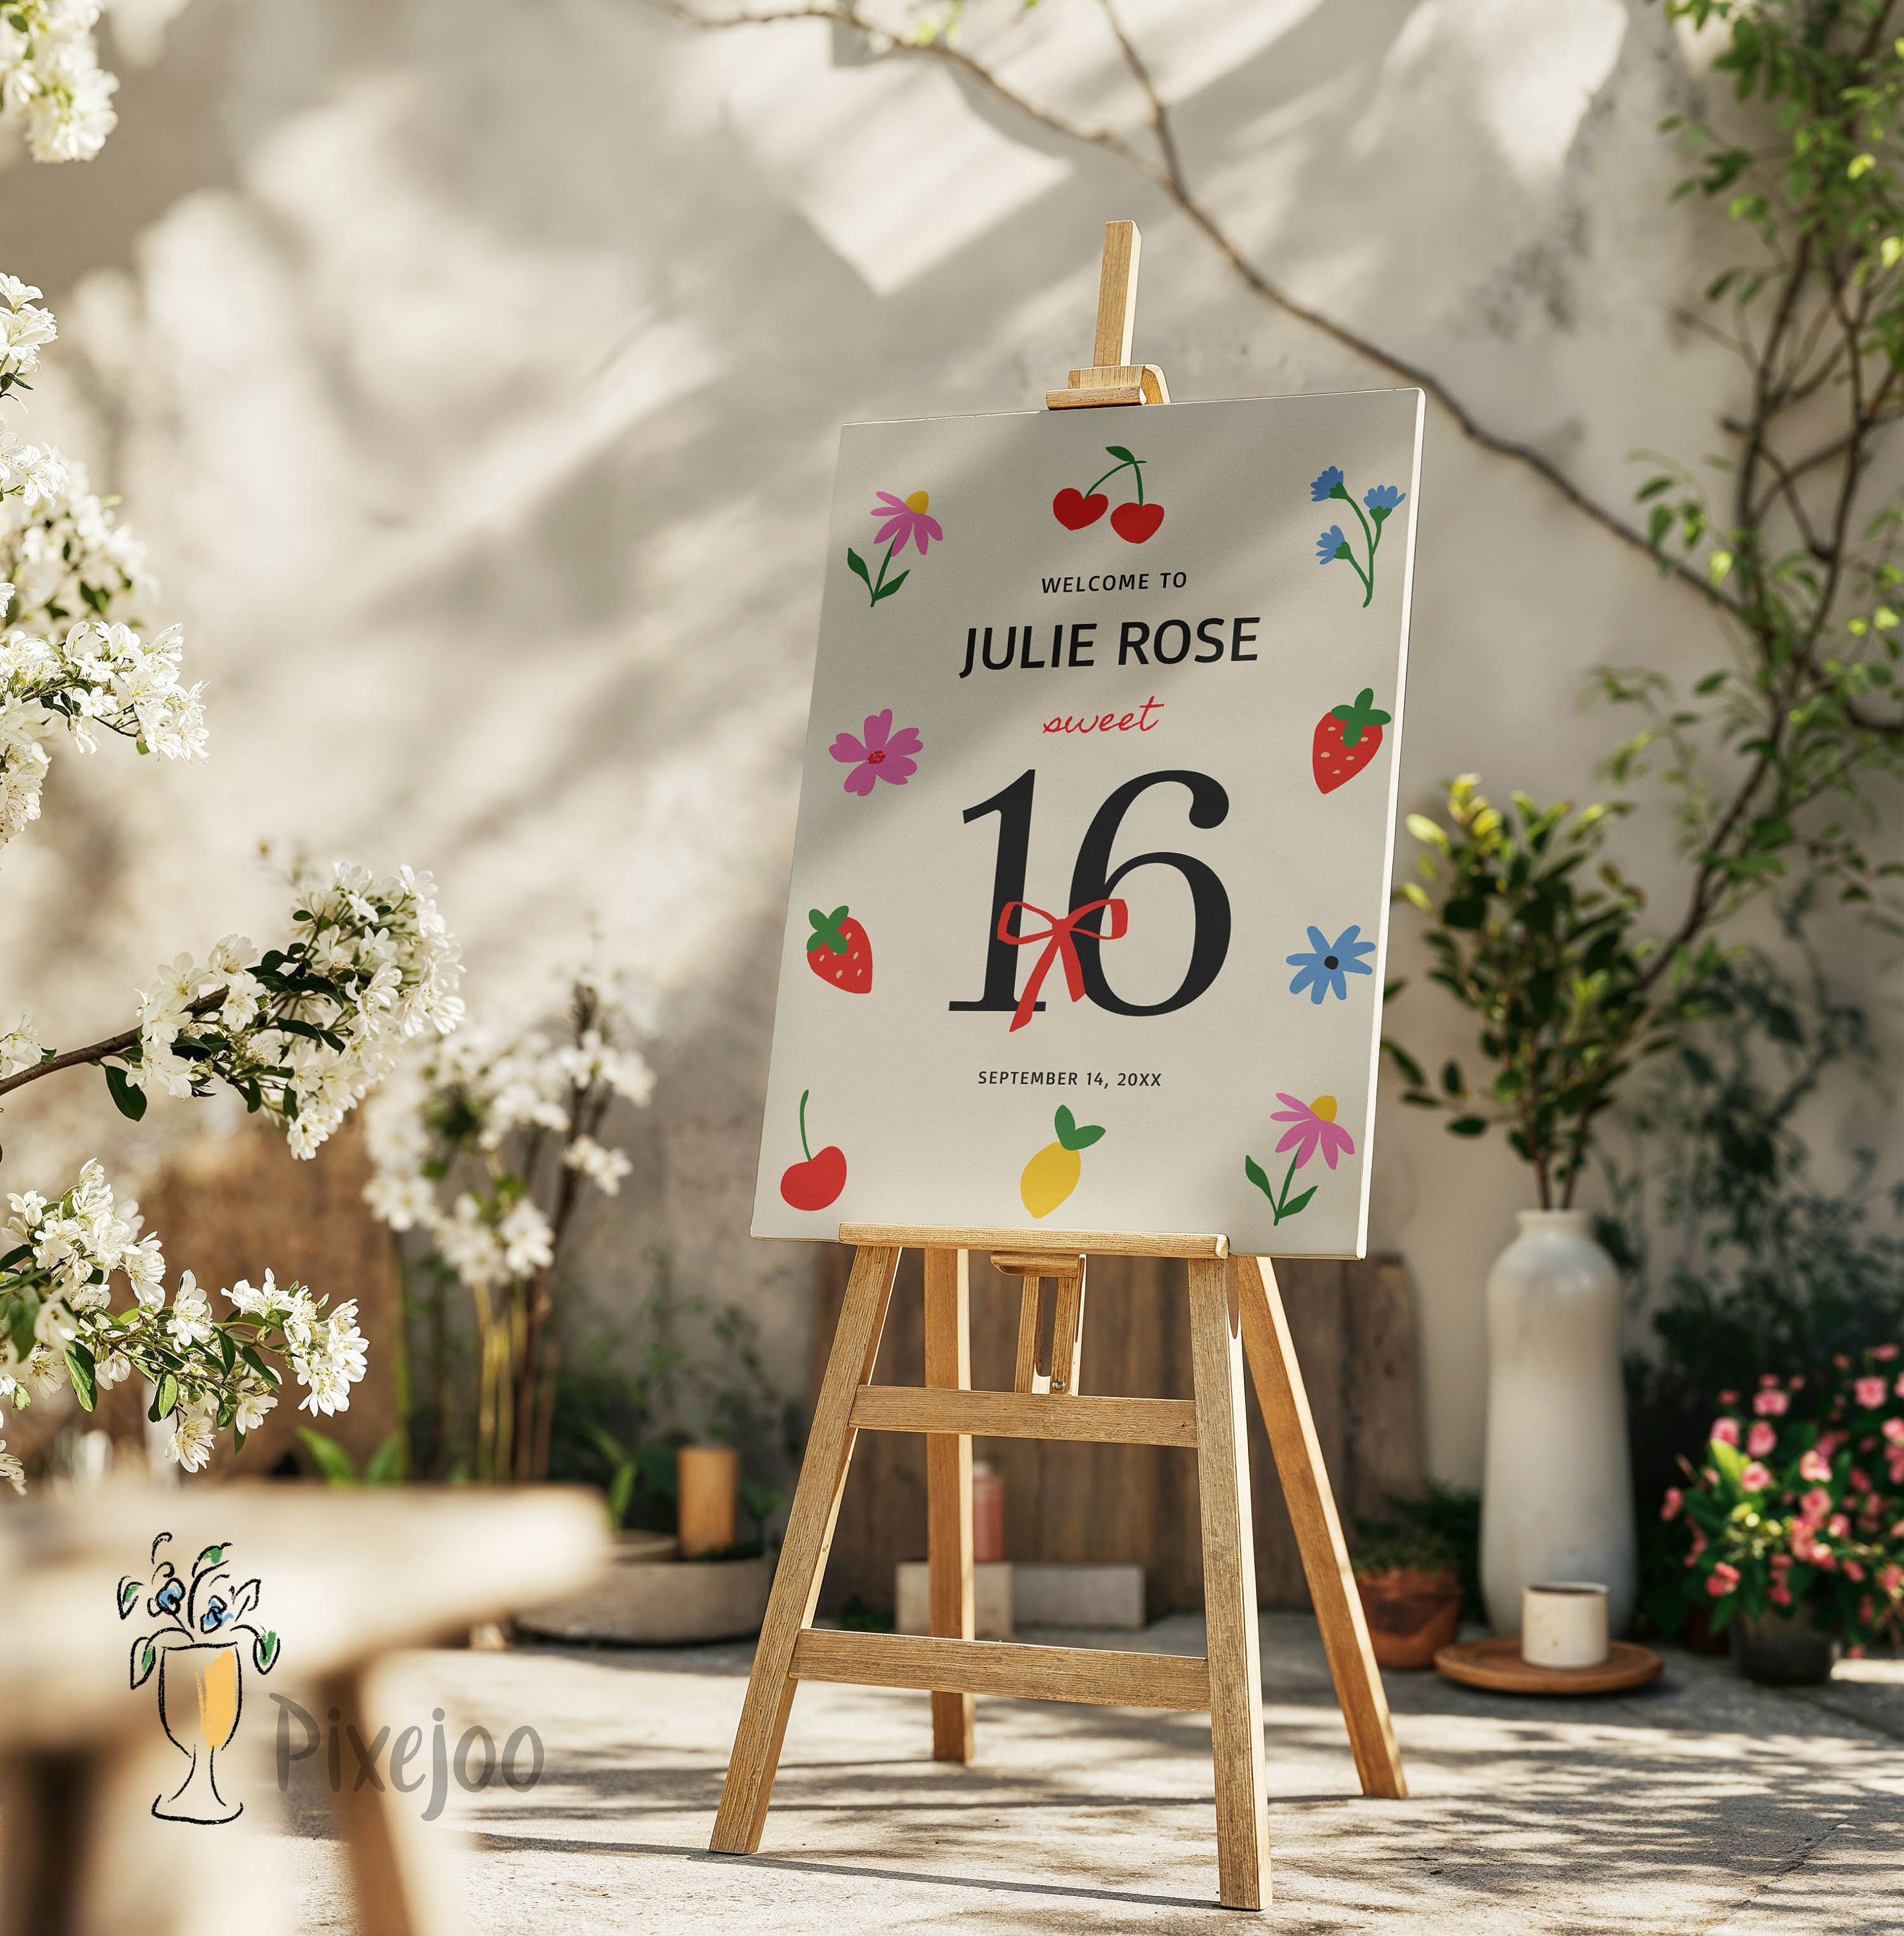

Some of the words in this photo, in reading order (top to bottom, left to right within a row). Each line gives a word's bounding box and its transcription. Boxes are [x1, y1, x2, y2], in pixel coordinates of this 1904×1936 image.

[1041, 573, 1150, 594] WELCOME
[1159, 571, 1187, 589] TO
[959, 623, 1097, 679] JULIE
[1117, 617, 1261, 665] ROSE
[1042, 696, 1165, 734] sweet
[948, 769, 1231, 1018] 16
[977, 1071, 1078, 1085] SEPTEMBER
[1086, 1072, 1109, 1089] 14,
[1117, 1073, 1162, 1087] 20XX
